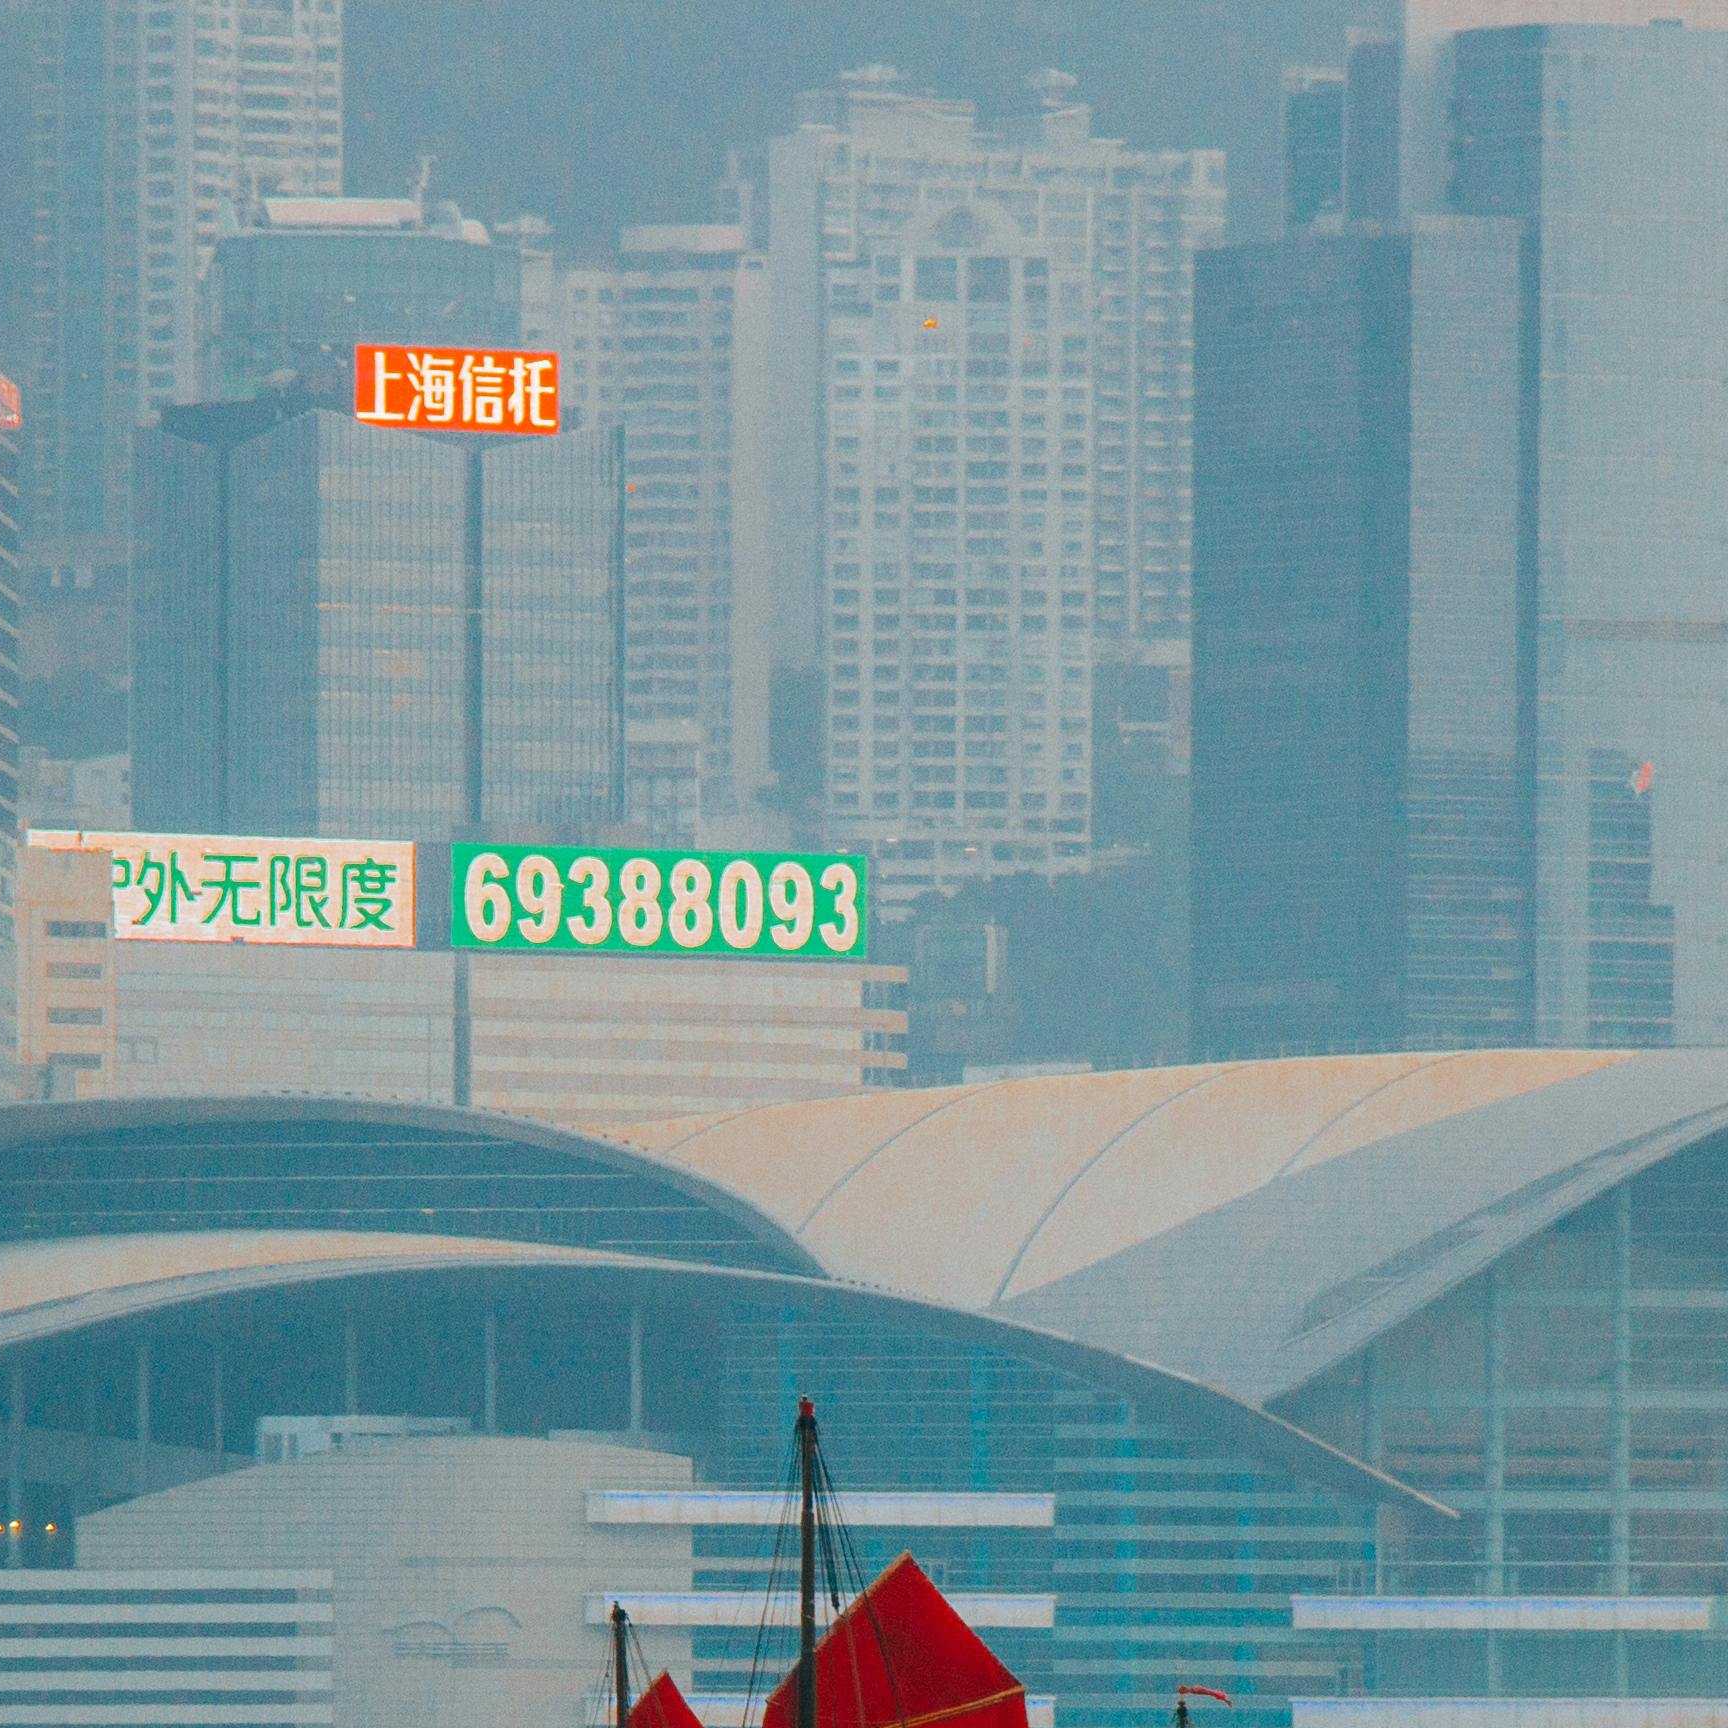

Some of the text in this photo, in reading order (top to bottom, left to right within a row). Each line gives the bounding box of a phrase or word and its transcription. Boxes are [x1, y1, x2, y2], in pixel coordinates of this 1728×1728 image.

[355, 351, 556, 427] 上海信托
[464, 852, 860, 952] 69388093
